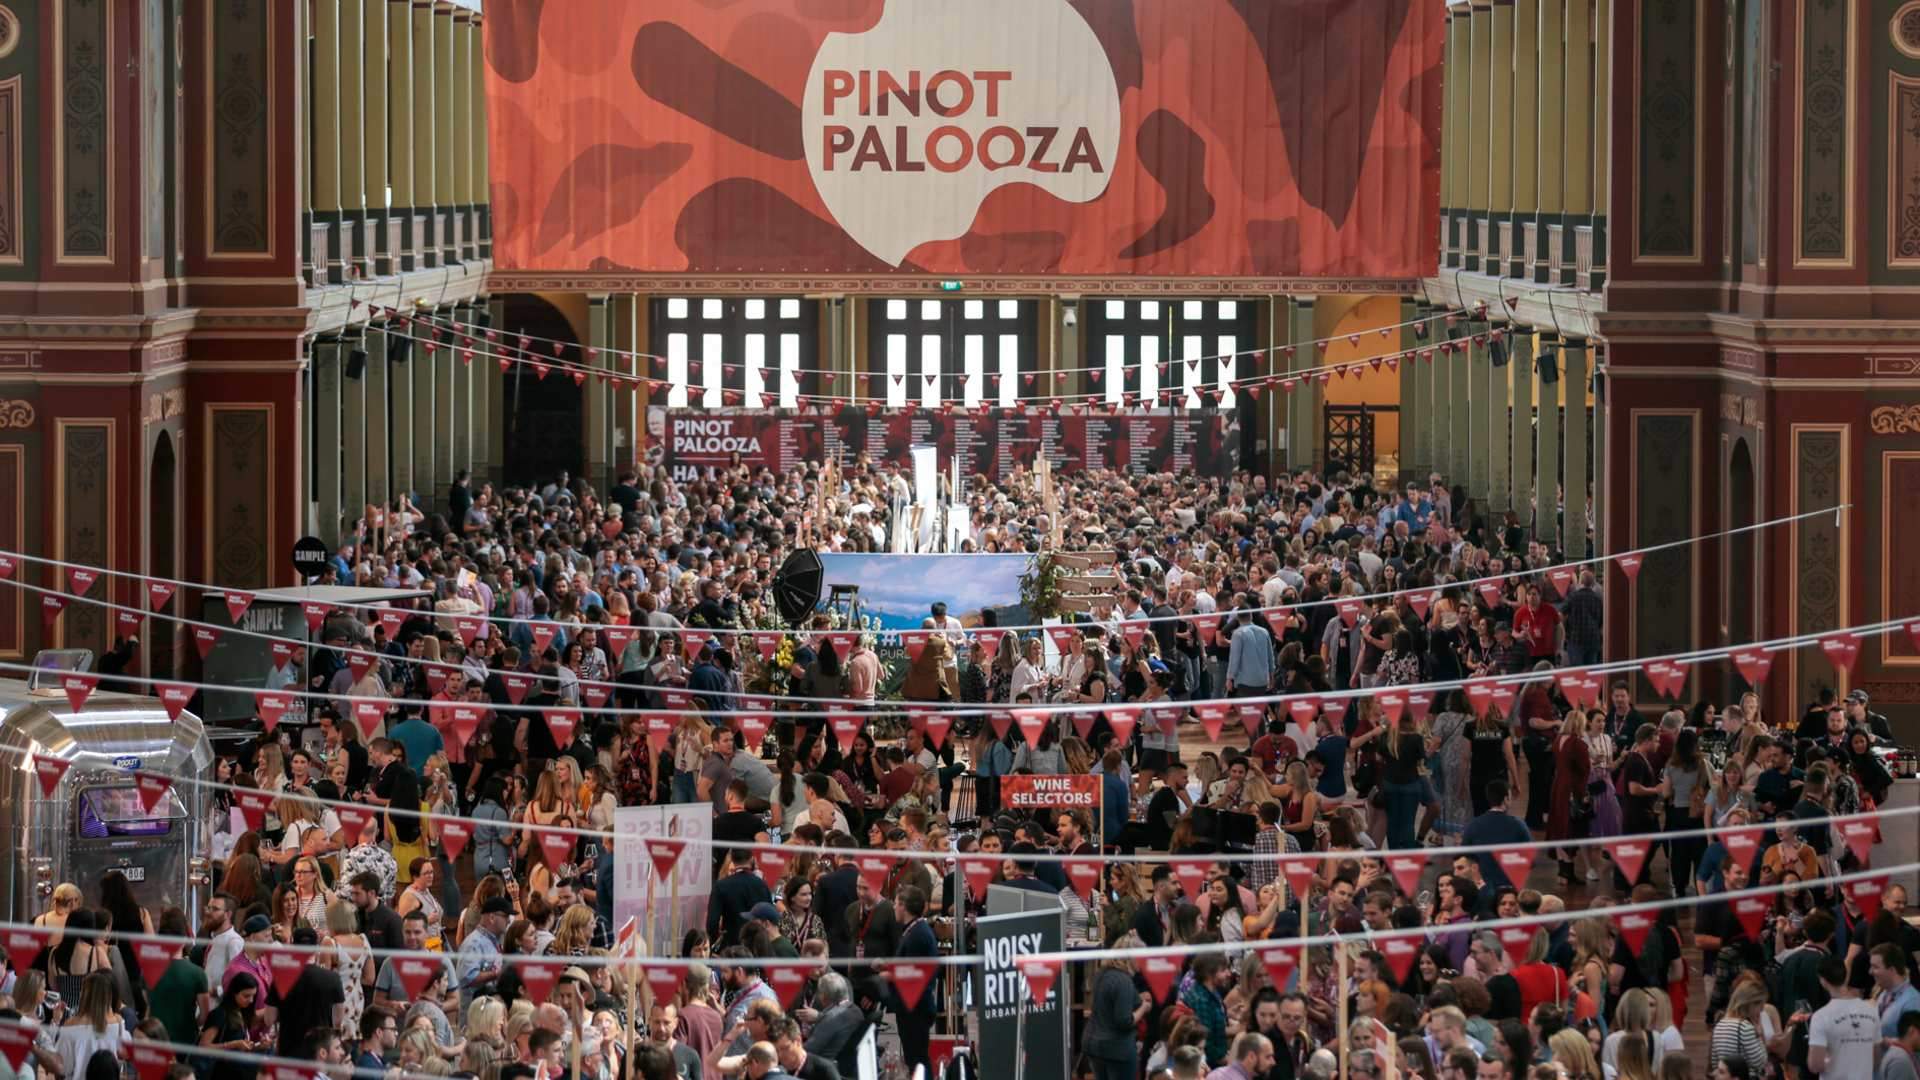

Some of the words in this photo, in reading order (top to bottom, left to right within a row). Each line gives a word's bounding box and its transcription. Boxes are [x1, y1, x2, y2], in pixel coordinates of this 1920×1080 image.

[823, 69, 1012, 118] PINOT
[823, 125, 1104, 173] PALOOZA
[674, 420, 733, 436] PINOT
[674, 437, 761, 453] PALOOZA
[673, 465, 717, 481] HAL
[295, 550, 325, 562] SAMPLE
[243, 607, 284, 632] SAMPLE
[1033, 779, 1071, 791] WINE
[1012, 793, 1092, 805] SELECTORS
[984, 933, 1042, 971] NOISY
[985, 1006, 1016, 1019] URBAN
